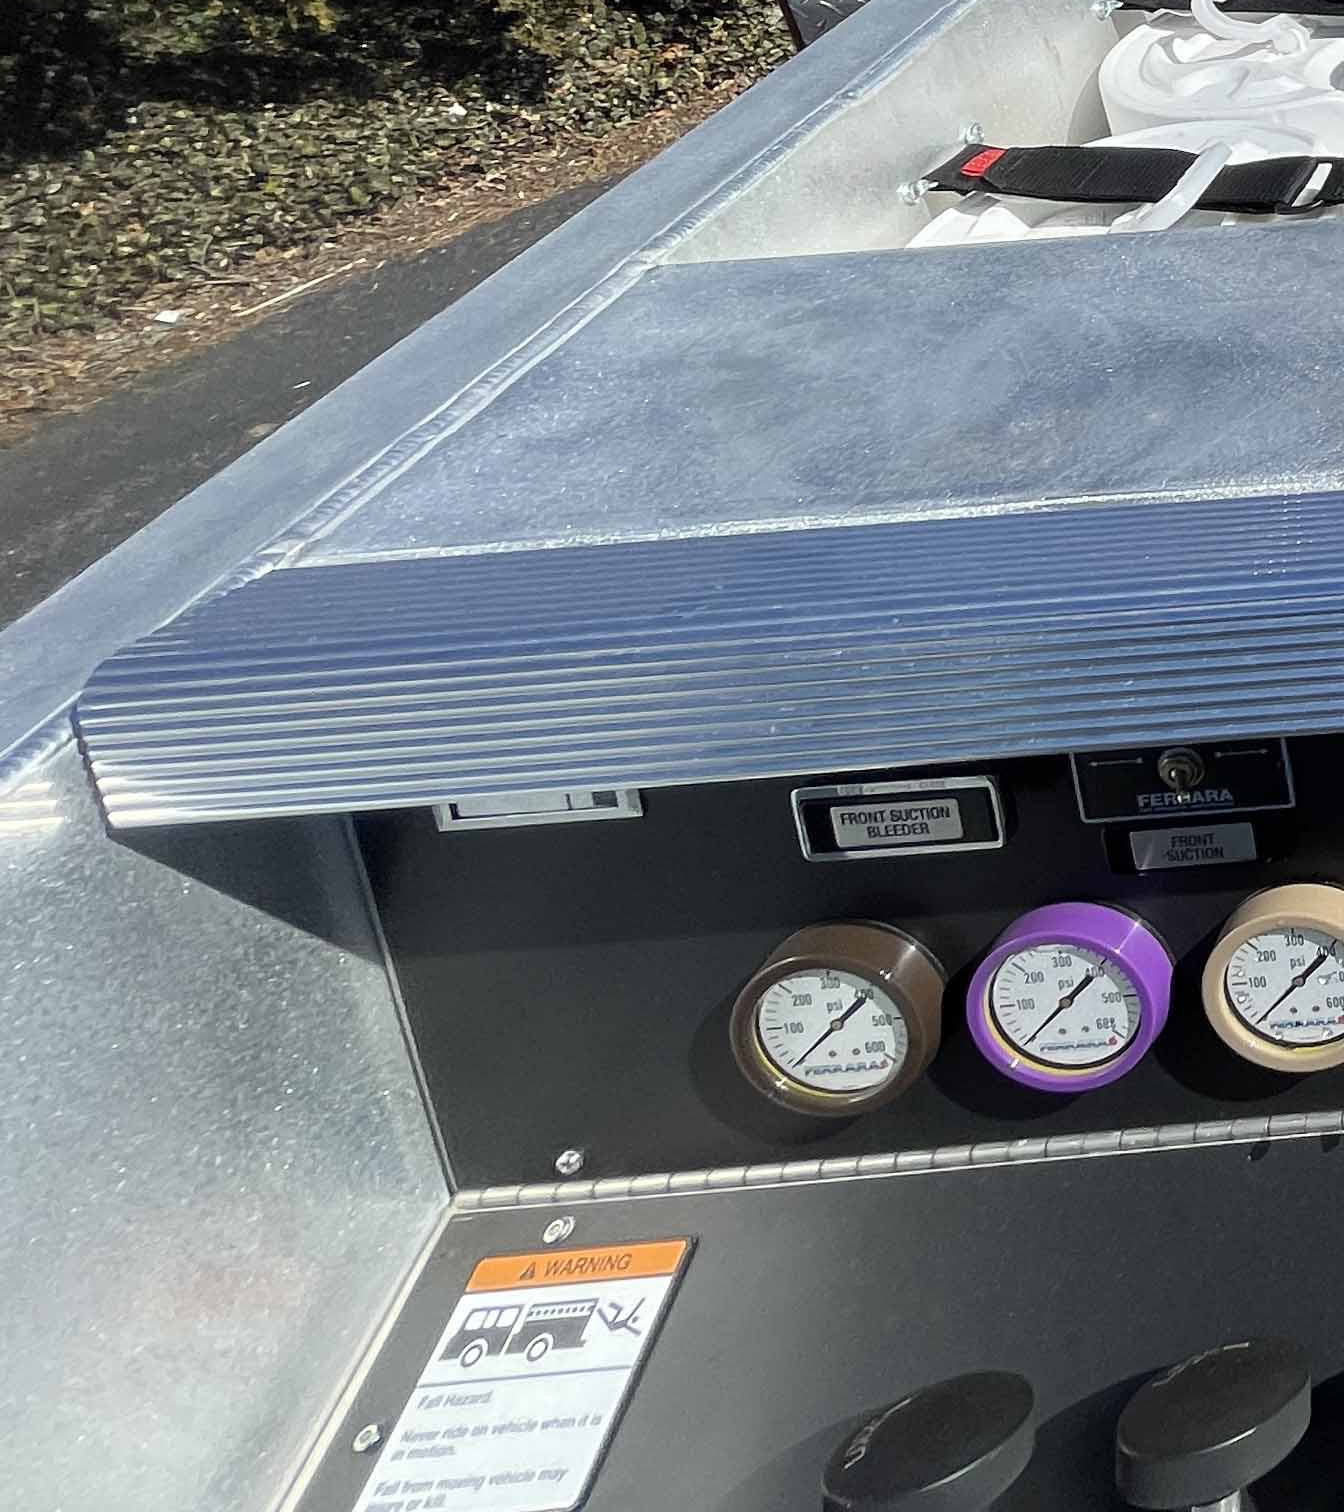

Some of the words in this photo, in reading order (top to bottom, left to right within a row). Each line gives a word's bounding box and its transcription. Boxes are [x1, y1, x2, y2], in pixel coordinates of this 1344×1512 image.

[840, 809, 886, 826] FRONT
[889, 806, 950, 823] SUCTION
[866, 822, 930, 838] BLEEDER
[1170, 833, 1216, 849] FRONT
[1166, 846, 1224, 862] SUCTION
[1256, 950, 1276, 962] 200
[1290, 957, 1306, 969] psi
[1023, 971, 1044, 985] 200
[1249, 976, 1267, 988] 100
[1057, 979, 1074, 991] psi
[791, 993, 813, 1007] 200
[1101, 991, 1122, 1003] 500
[826, 1000, 843, 1014] psi
[1016, 998, 1035, 1010] 100
[871, 1014, 893, 1027] 500
[783, 1022, 804, 1034] 100
[864, 1040, 886, 1053] 600
[544, 1253, 632, 1278] WARNING
